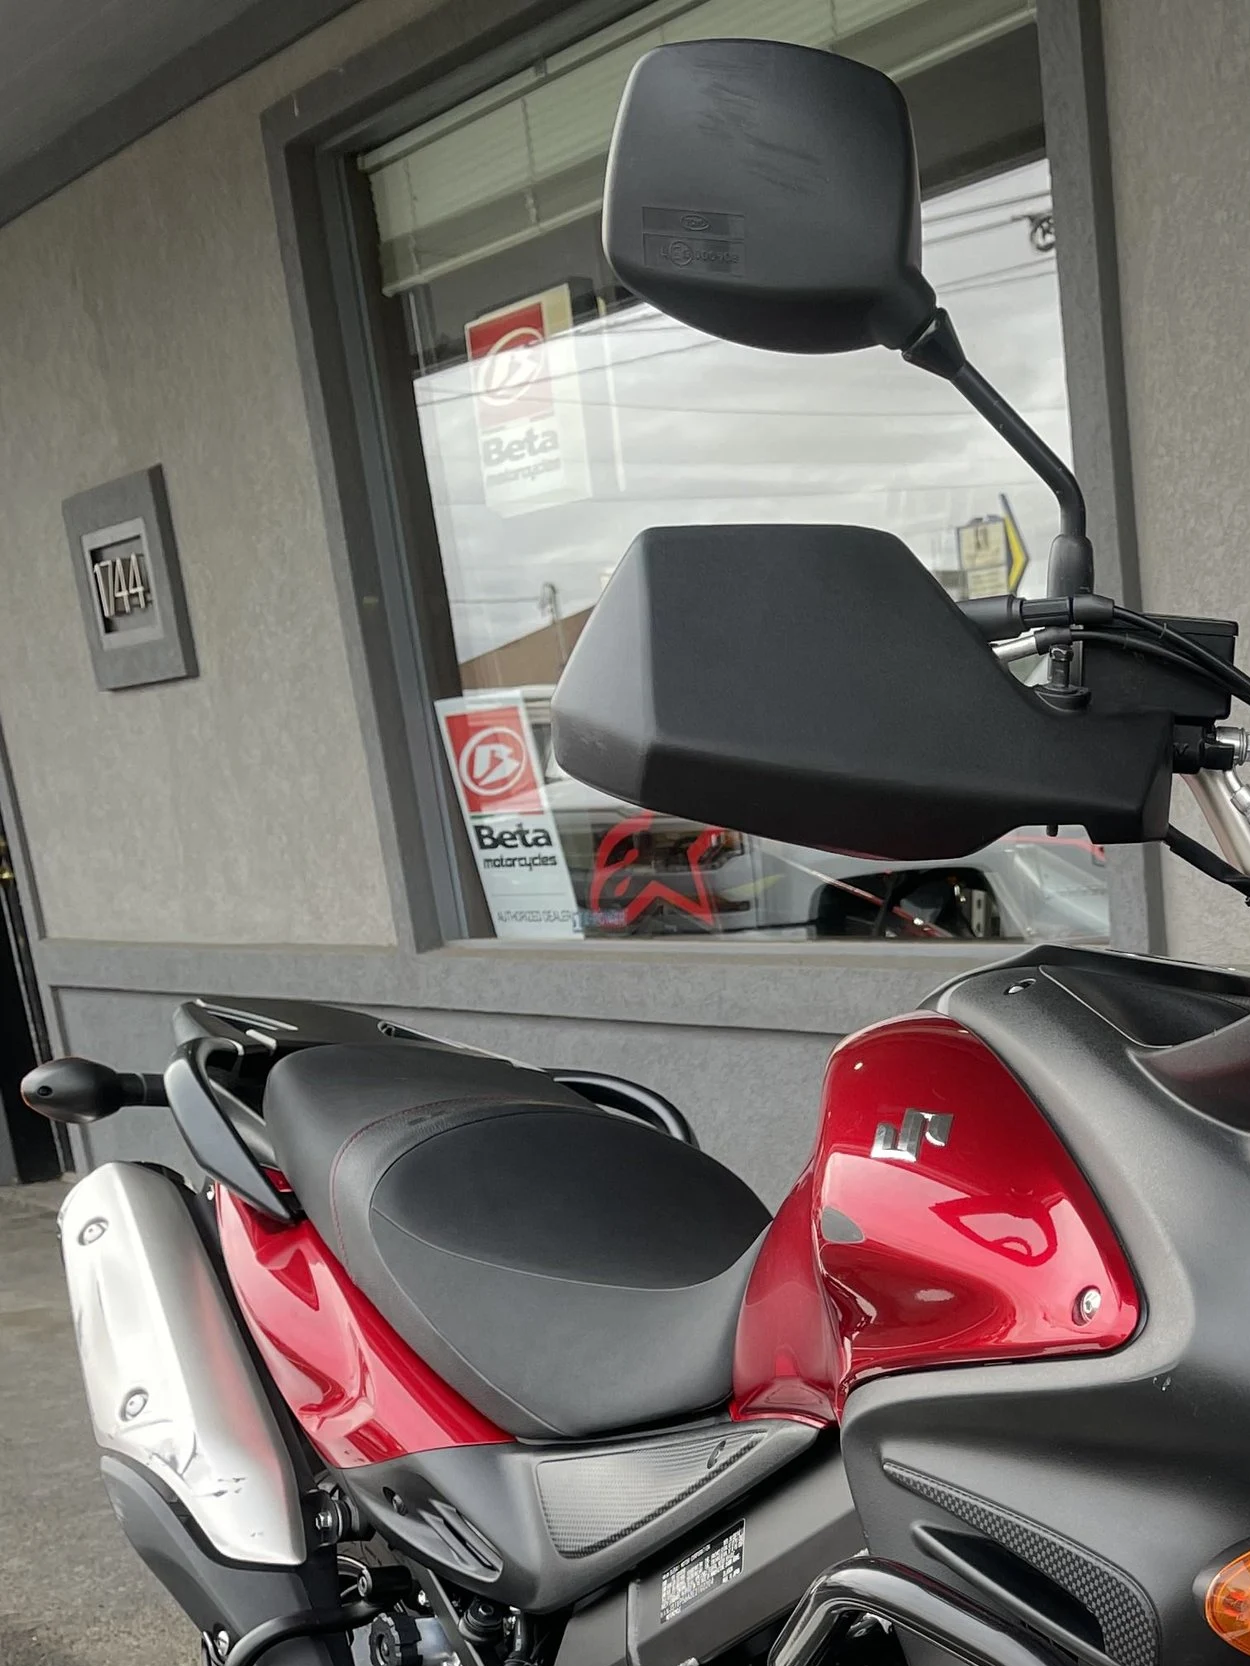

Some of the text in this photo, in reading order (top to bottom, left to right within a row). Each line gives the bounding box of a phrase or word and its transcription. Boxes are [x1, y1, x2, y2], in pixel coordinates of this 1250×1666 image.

[483, 427, 559, 467] Beta
[473, 822, 553, 850] Beta
[482, 853, 558, 872] motorcycles
